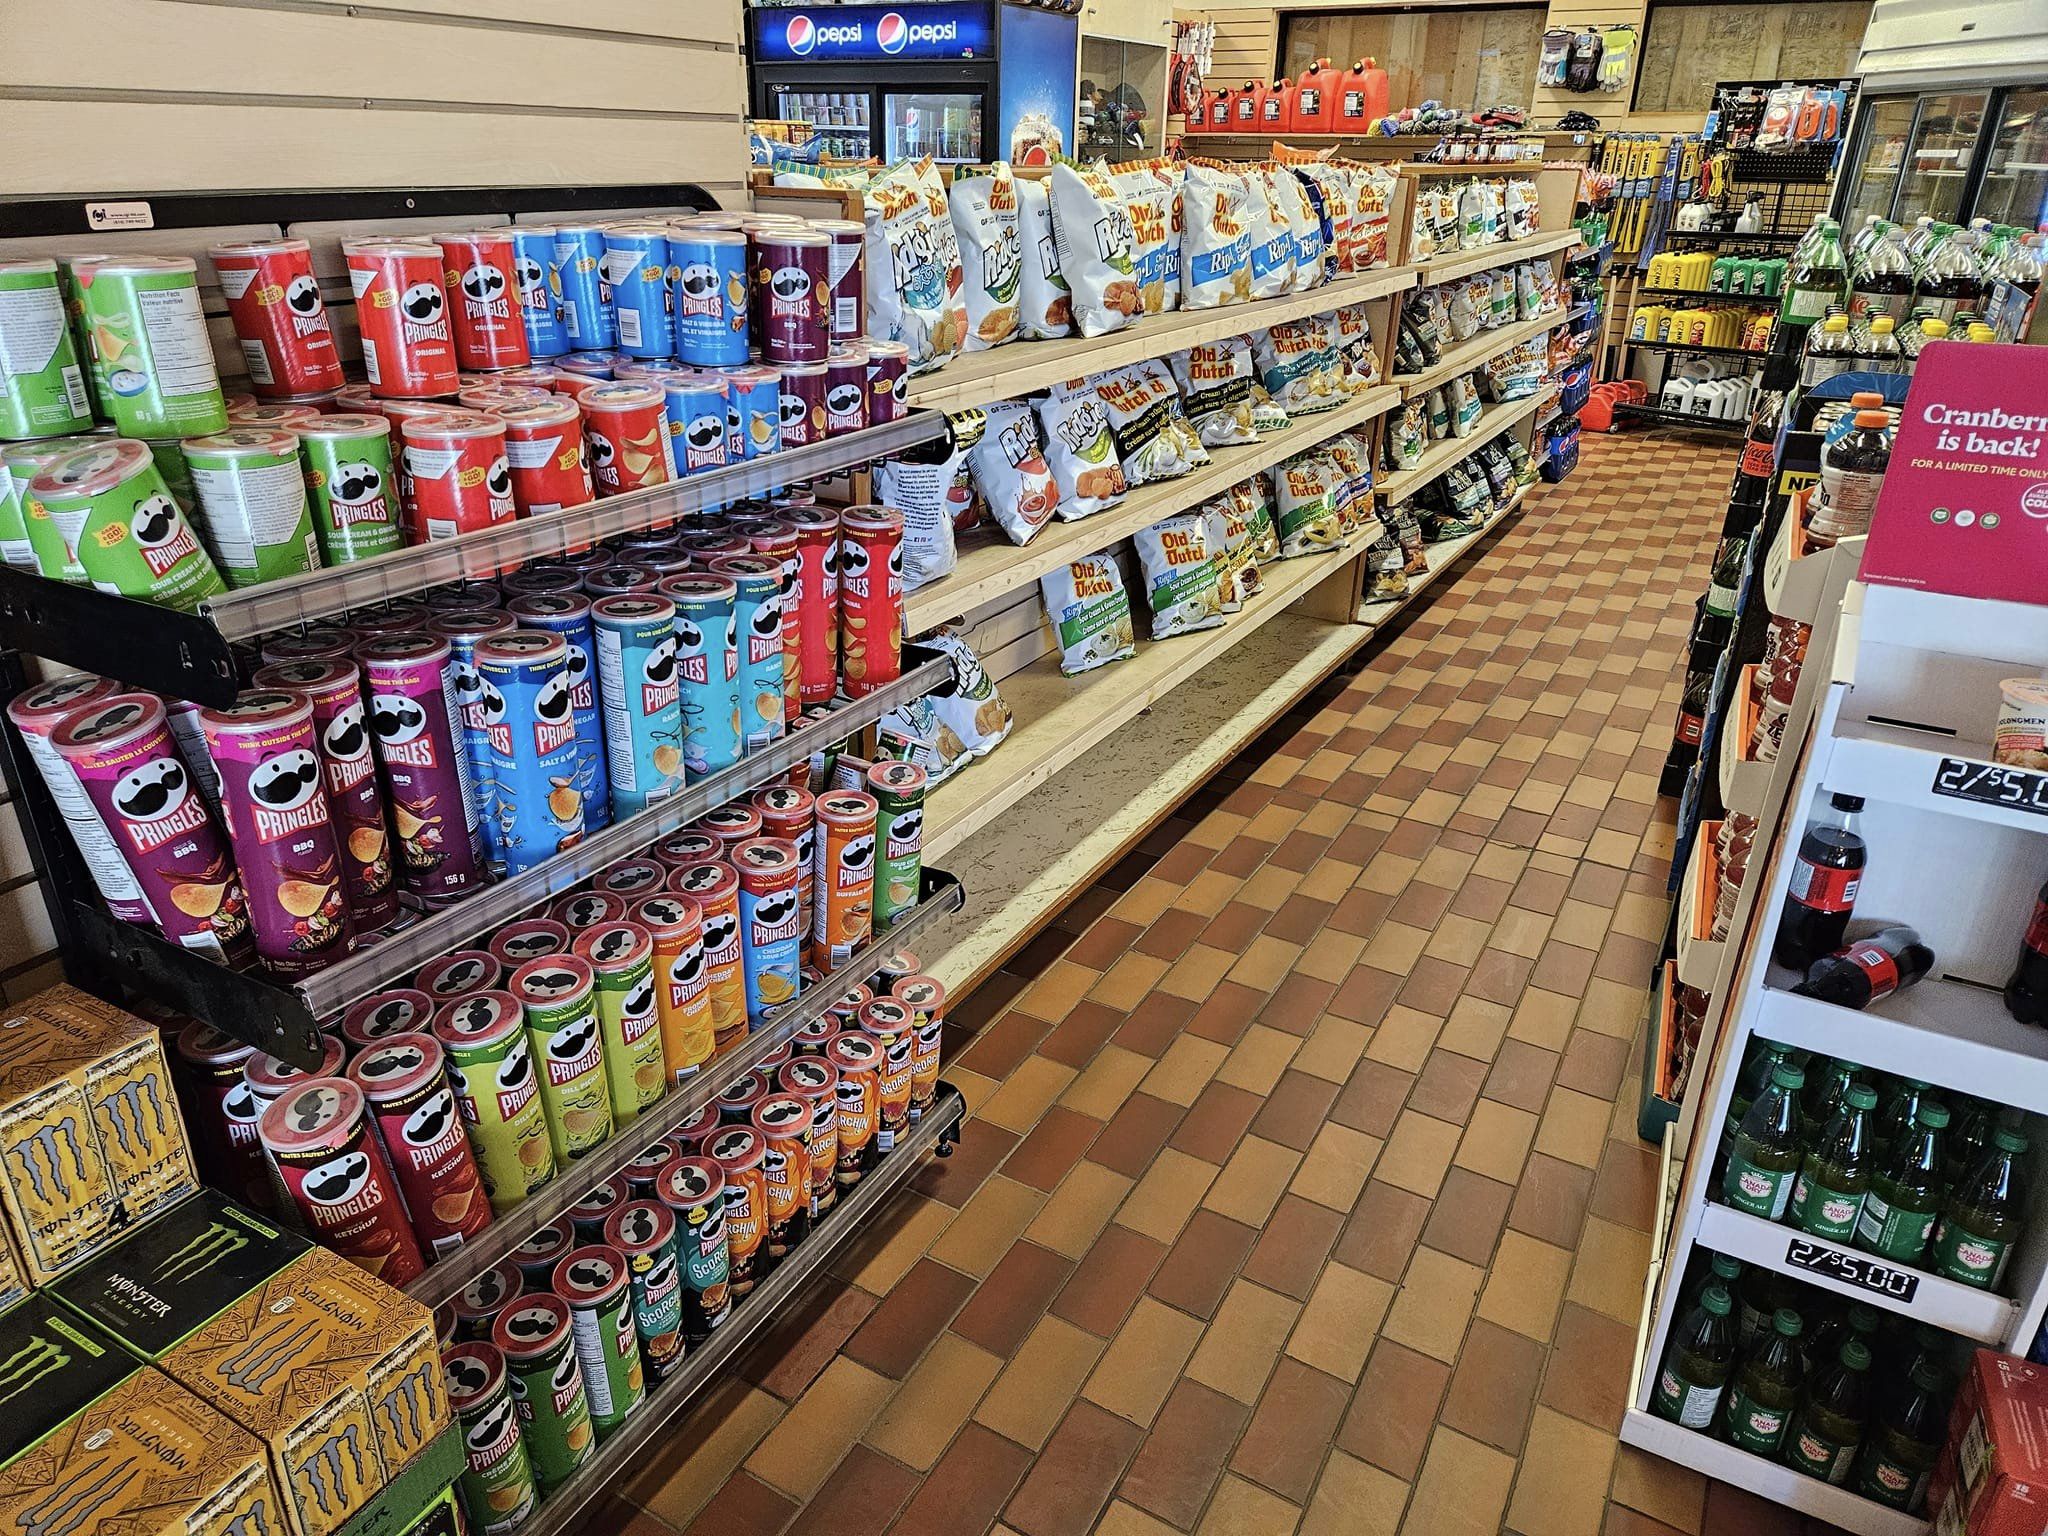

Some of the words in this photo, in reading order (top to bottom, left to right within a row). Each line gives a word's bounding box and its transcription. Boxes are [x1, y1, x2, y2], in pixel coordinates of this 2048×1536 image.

[817, 22, 862, 46] pepsi
[909, 20, 957, 44] pepsi
[465, 298, 510, 320] PRINGLES
[683, 295, 723, 318] PRINGLES
[772, 297, 810, 318] PRINGLES
[405, 319, 448, 346] PRINGLES
[1270, 326, 1293, 339] Old
[415, 347, 446, 356] ORIGINAL
[1191, 347, 1216, 362] Old
[1275, 338, 1311, 353] Dutch
[1191, 362, 1235, 379] Dutch
[1097, 382, 1124, 400] Old
[828, 410, 863, 430] PRINGLES
[1936, 429, 1961, 451] is
[1966, 433, 2041, 458] back!
[688, 446, 725, 468] PRINGLES
[1911, 458, 1934, 468] FOR
[1946, 462, 1989, 473] LIMITED
[1991, 466, 2017, 476] TIME
[2019, 468, 2048, 479] ONLY
[1290, 484, 1324, 497] Dutch
[333, 498, 387, 528] PRINGLES
[148, 527, 197, 573] PRINGLES
[1162, 532, 1188, 548] Old
[1071, 563, 1094, 579] Old
[151, 576, 173, 591] SOUR
[529, 664, 546, 673] THINK
[315, 695, 335, 705] THINK
[238, 740, 260, 749] THINK
[261, 734, 290, 747] OUTSIDE
[290, 730, 301, 739] THE
[105, 752, 134, 767] SAUTER
[539, 757, 559, 768] SALT
[393, 774, 411, 784] BBQ
[360, 788, 374, 800] BBQ
[127, 795, 207, 850] PRINGLES
[255, 792, 328, 839] PRINGLES
[174, 843, 198, 858] BBQ
[293, 840, 315, 852] BBQ
[444, 874, 458, 885] 156
[753, 919, 797, 946] PRINGLES
[551, 1047, 600, 1084] PRINGLES
[561, 1083, 579, 1096] DILL
[302, 1150, 324, 1158] SAUTER
[410, 1116, 466, 1171] PRINGLES
[119, 1146, 186, 1190] MONSTER
[431, 1151, 465, 1179] KETCHUP
[1746, 1184, 1762, 1195] DRY
[311, 1180, 382, 1227] PRINGLES
[1754, 1203, 1767, 1211] ALE
[32, 1191, 111, 1240] MONSTER
[1830, 1211, 1846, 1220] DRY
[334, 1216, 378, 1239] KETCHUP
[1791, 1241, 1909, 1296] 2/$5.00
[1965, 1255, 1983, 1266] DRY
[107, 1273, 172, 1318] MONSTER
[647, 1274, 678, 1304] PRINGLES
[104, 1290, 148, 1319] ENERGY
[298, 1285, 368, 1331] MONSTER
[117, 1415, 190, 1472] MONSTER
[472, 1426, 519, 1471] PRINGLES
